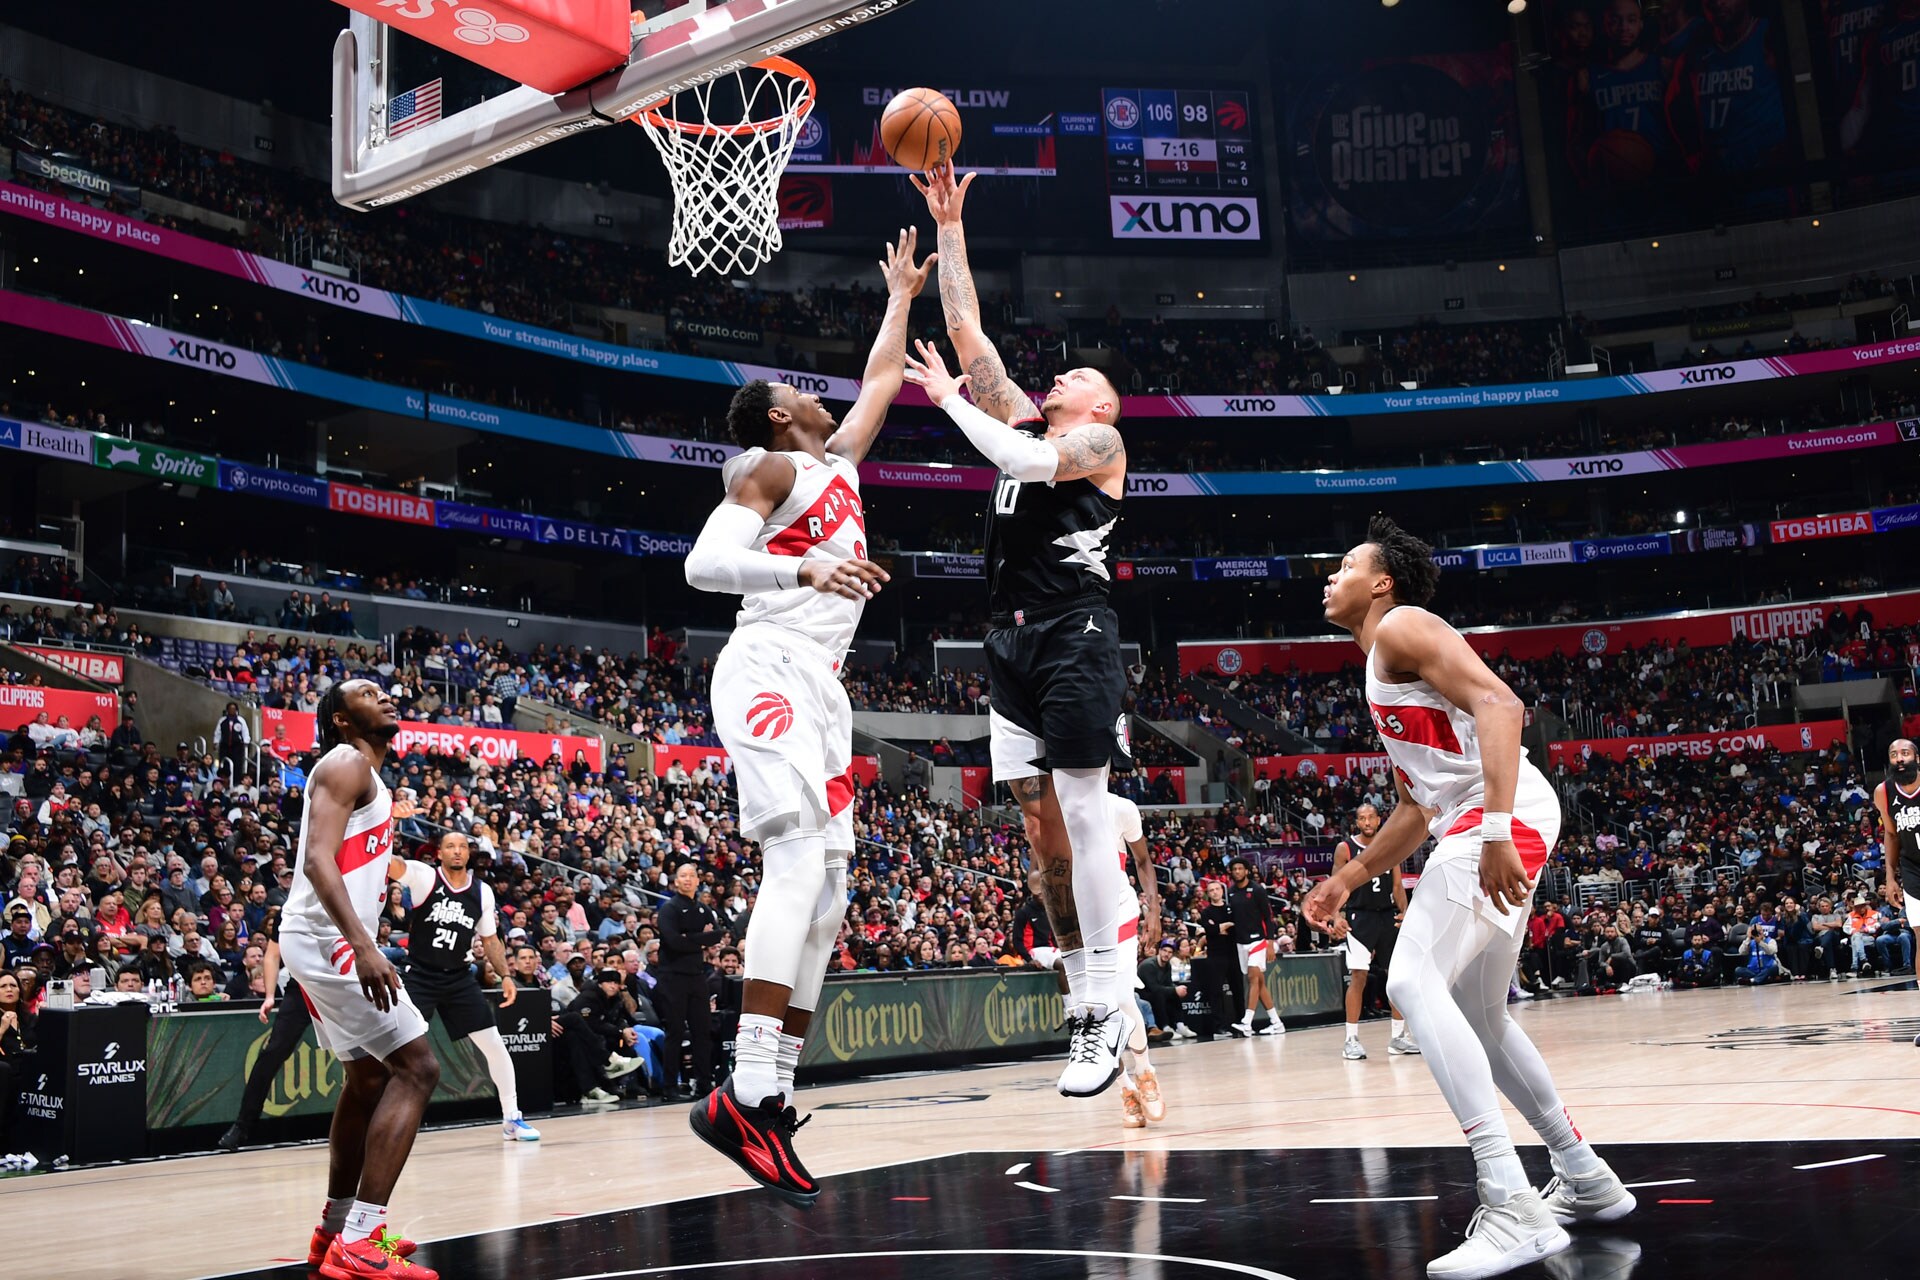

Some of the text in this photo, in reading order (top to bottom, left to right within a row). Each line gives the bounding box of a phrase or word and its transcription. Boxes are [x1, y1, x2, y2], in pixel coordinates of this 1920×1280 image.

[761, 30, 820, 56] HERDEZ
[615, 90, 670, 118] HERDEZ
[1147, 104, 1173, 121] 106
[1061, 116, 1097, 124] CURRENT
[1183, 105, 1208, 122] 98
[1625, 107, 1640, 131] 7
[1709, 98, 1731, 129] 17
[487, 140, 534, 164] HERDEZ
[1115, 143, 1134, 151] LAC
[1161, 142, 1200, 157] 7:16
[1225, 145, 1244, 154] TOR
[1133, 159, 1140, 167] 4
[1175, 161, 1189, 171] 13
[1240, 161, 1247, 171] 2
[40, 159, 111, 193] Spectrum
[1134, 175, 1141, 184] 2
[1241, 177, 1248, 186] 0
[365, 189, 412, 208] HERDEZ
[0, 190, 161, 245] aming happy place
[1119, 202, 1251, 234] xumo
[301, 273, 360, 304] xumo
[687, 321, 759, 342] crypto.com
[168, 337, 236, 371] xumo
[483, 321, 659, 369] Your streaming happy place
[1853, 341, 1920, 361] Your strea
[778, 372, 829, 393] xumo
[1680, 365, 1735, 385] xumo
[1224, 398, 1275, 412] xumo
[1384, 387, 1559, 408] Your streaming happy place
[1904, 420, 1916, 428] TOL
[1909, 427, 1918, 438] 4
[27, 429, 85, 456] Health
[1788, 430, 1877, 450] tv.xumo.com
[670, 443, 726, 464] xumo
[152, 452, 205, 478] Sprite
[1568, 458, 1623, 476] xumo
[879, 467, 963, 484] tv.xumo.com
[1315, 475, 1397, 488] tv.xumo.com
[250, 474, 318, 498] crypto.com
[1127, 477, 1168, 493] umo
[334, 487, 430, 522] TOSHIBA
[808, 488, 864, 539] RAPTO
[491, 517, 530, 533] ULTRA
[1774, 515, 1867, 540] TOSHIBA
[1877, 511, 1919, 526] Michelob
[563, 525, 623, 548] DELTA
[639, 534, 694, 555] Spectru
[1488, 548, 1566, 563] UCLA Health
[1600, 539, 1660, 556] crypto.com
[931, 556, 985, 566] The LA Clippe
[1136, 565, 1177, 575] TOYOTA
[1215, 560, 1267, 570] AMERICAN
[944, 566, 980, 575] Welcome
[1222, 568, 1269, 578] EXPRESS
[1751, 608, 1824, 639] CLIPPERS
[0, 687, 44, 708] CLIPPERS
[96, 696, 113, 708] 101
[266, 709, 283, 720] 102
[391, 728, 518, 760] IPPERS.COM
[1549, 743, 1562, 752] 106
[1626, 734, 1765, 762] CLIPPERS.COM
[1256, 757, 1269, 766] 105
[1345, 755, 1391, 778] CLIPPE
[1305, 853, 1333, 863] ULTR
[1372, 877, 1381, 892] 2
[441, 897, 463, 912] Los
[424, 901, 475, 930] Angeles
[432, 927, 458, 951] 24
[150, 1003, 179, 1014] anc
[984, 979, 1064, 1047] Cuervo
[826, 988, 924, 1061] Cuervo
[501, 1033, 547, 1044] STARLUX
[507, 1043, 540, 1052] AIRLINES
[78, 1059, 145, 1077] STARLUX
[89, 1073, 135, 1085] AIRLINES
[20, 1092, 63, 1110] STARLUX
[27, 1107, 57, 1119] AIRLINES
